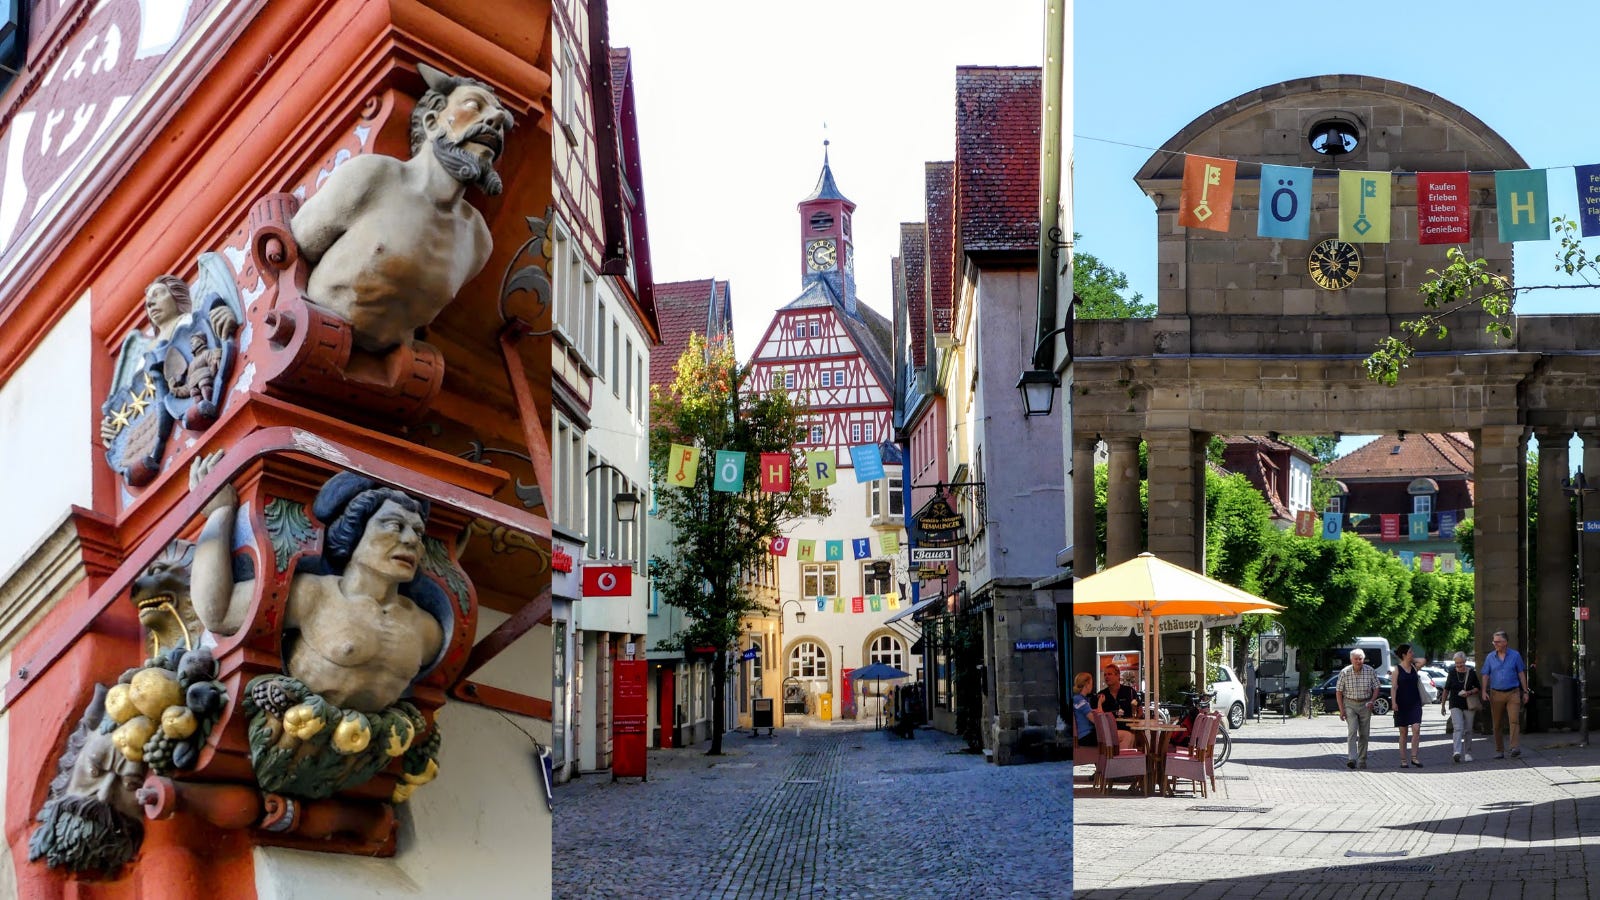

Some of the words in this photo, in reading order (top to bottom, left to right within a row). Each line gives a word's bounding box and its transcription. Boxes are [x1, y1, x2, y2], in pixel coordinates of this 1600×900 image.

[1590, 174, 1600, 183] Fe
[1429, 183, 1456, 191] Kaufen
[1271, 179, 1298, 223] Ö
[1428, 193, 1457, 201] Erleben
[1430, 204, 1456, 212] Lieben
[1510, 191, 1536, 225] H
[1426, 225, 1462, 234] Genießen
[721, 458, 738, 483] Ö
[769, 464, 783, 484] H
[815, 461, 830, 480] R
[1327, 517, 1337, 534] Ö
[1413, 521, 1424, 534] H
[801, 545, 811, 556] H
[830, 546, 838, 556] R
[915, 550, 950, 559] Bauer
[1136, 619, 1198, 634] Hrsthäuser
